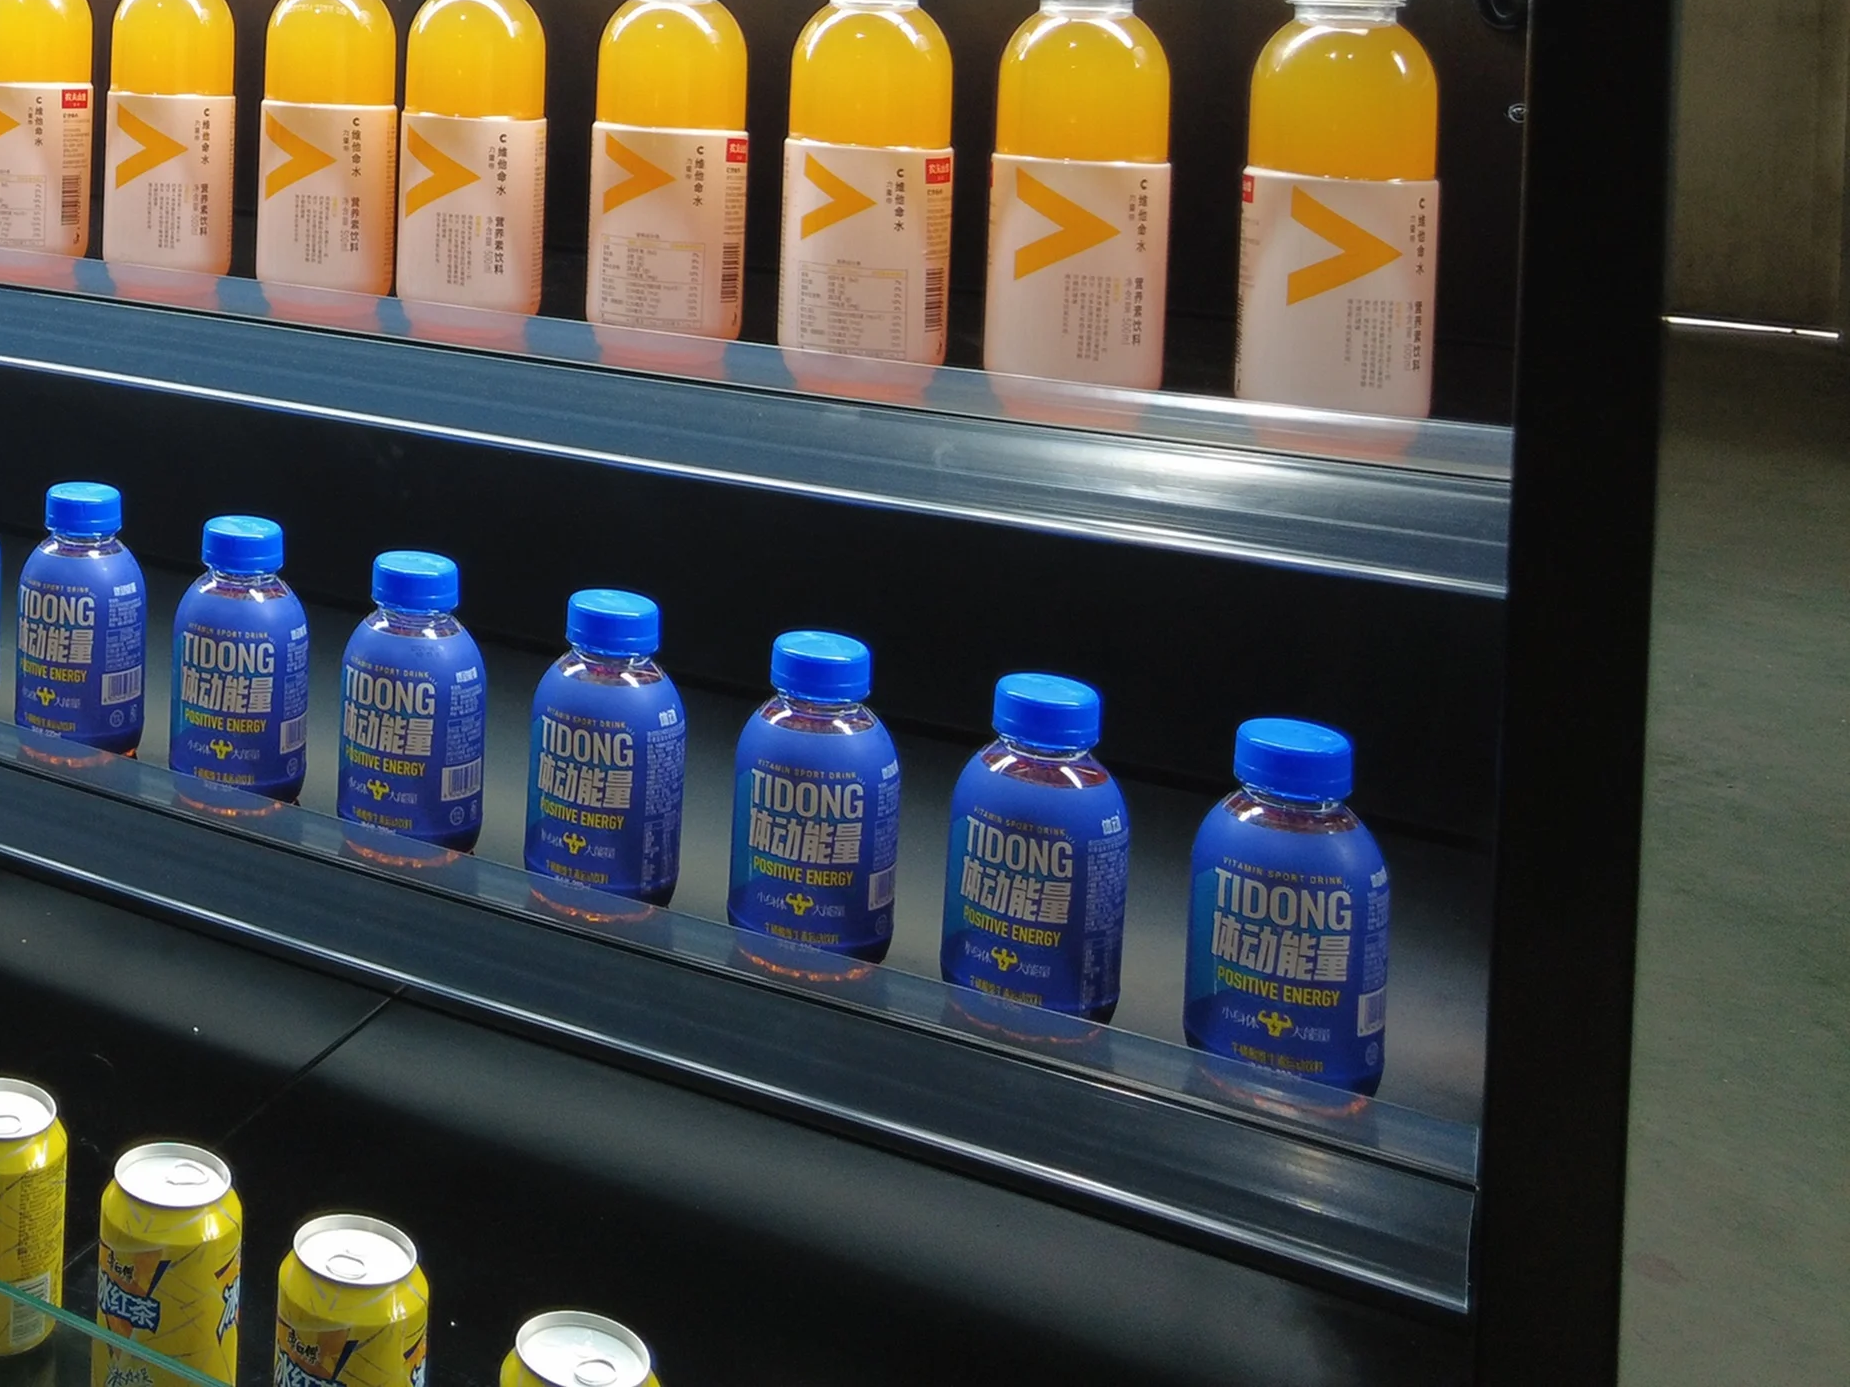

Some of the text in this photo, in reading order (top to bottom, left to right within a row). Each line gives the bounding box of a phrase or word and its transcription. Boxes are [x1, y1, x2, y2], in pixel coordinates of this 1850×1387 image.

[350, 196, 360, 253] 营养素饮料
[493, 216, 505, 276] 营养素饮料
[1132, 277, 1144, 347] 营养素饮料
[20, 584, 94, 626] TIDONG
[50, 664, 87, 682] ENERGY
[183, 631, 275, 674] TIDONG
[181, 665, 273, 713] 体动能量
[345, 664, 436, 715] TIDONG
[185, 708, 267, 733] POSITIVE ENERGY
[541, 714, 634, 767] TIDONG
[383, 758, 425, 777] ENERGY
[538, 751, 633, 809] 体动能量
[751, 768, 864, 819] TIDONG
[581, 811, 625, 830] ENERGY
[749, 808, 862, 865] 体动能量
[753, 855, 854, 886] POSITIVE ENERGY
[966, 815, 1073, 878] TIDONG
[1223, 856, 1343, 886] VITAMIN SPORT DRINK
[960, 855, 1072, 924] 体动能量
[1215, 867, 1351, 931] TIDONG
[963, 905, 1061, 947] POSITIVE ENERGY
[1211, 911, 1350, 982] 体动能量
[1217, 965, 1341, 1007] POSITIVE ENERGY
